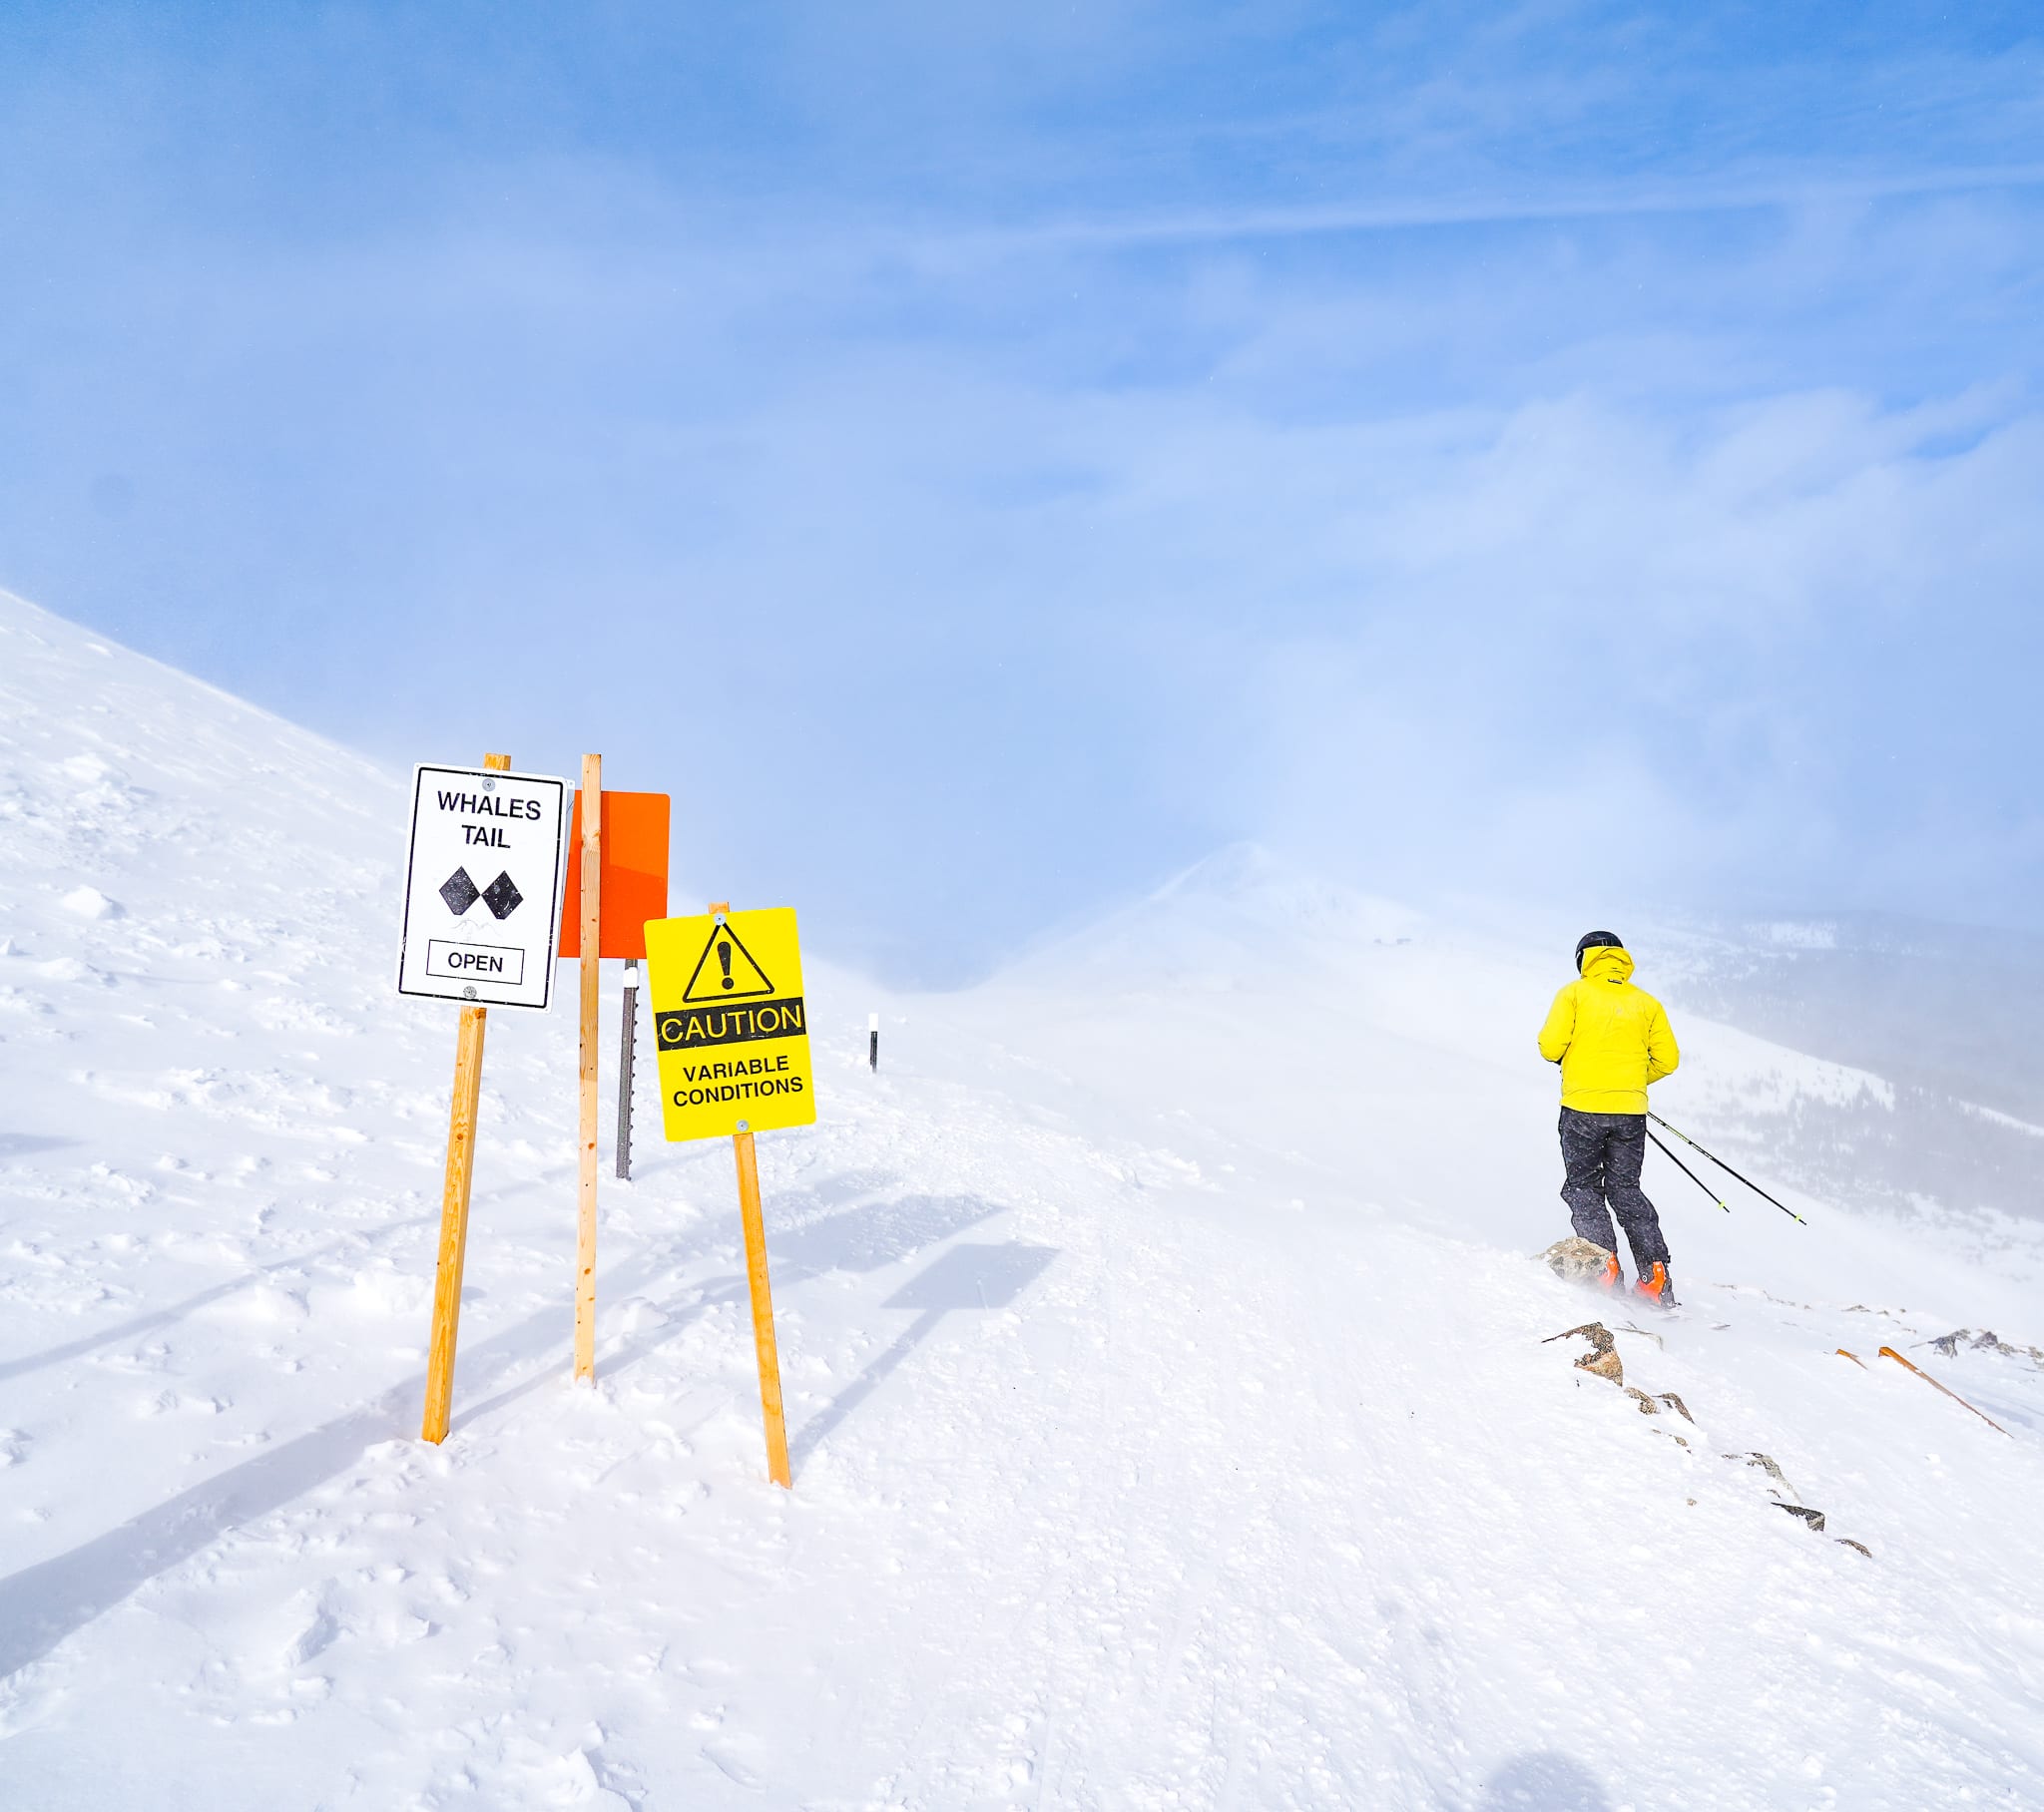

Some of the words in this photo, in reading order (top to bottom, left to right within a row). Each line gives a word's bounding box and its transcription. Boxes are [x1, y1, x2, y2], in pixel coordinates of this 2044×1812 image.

[437, 790, 542, 821] WHALES
[461, 824, 511, 849] TAIL
[447, 952, 503, 974] OPEN
[660, 1004, 803, 1044] CAUTION
[683, 1055, 789, 1083] VARIABLE
[673, 1077, 803, 1108] CONDITIONS
